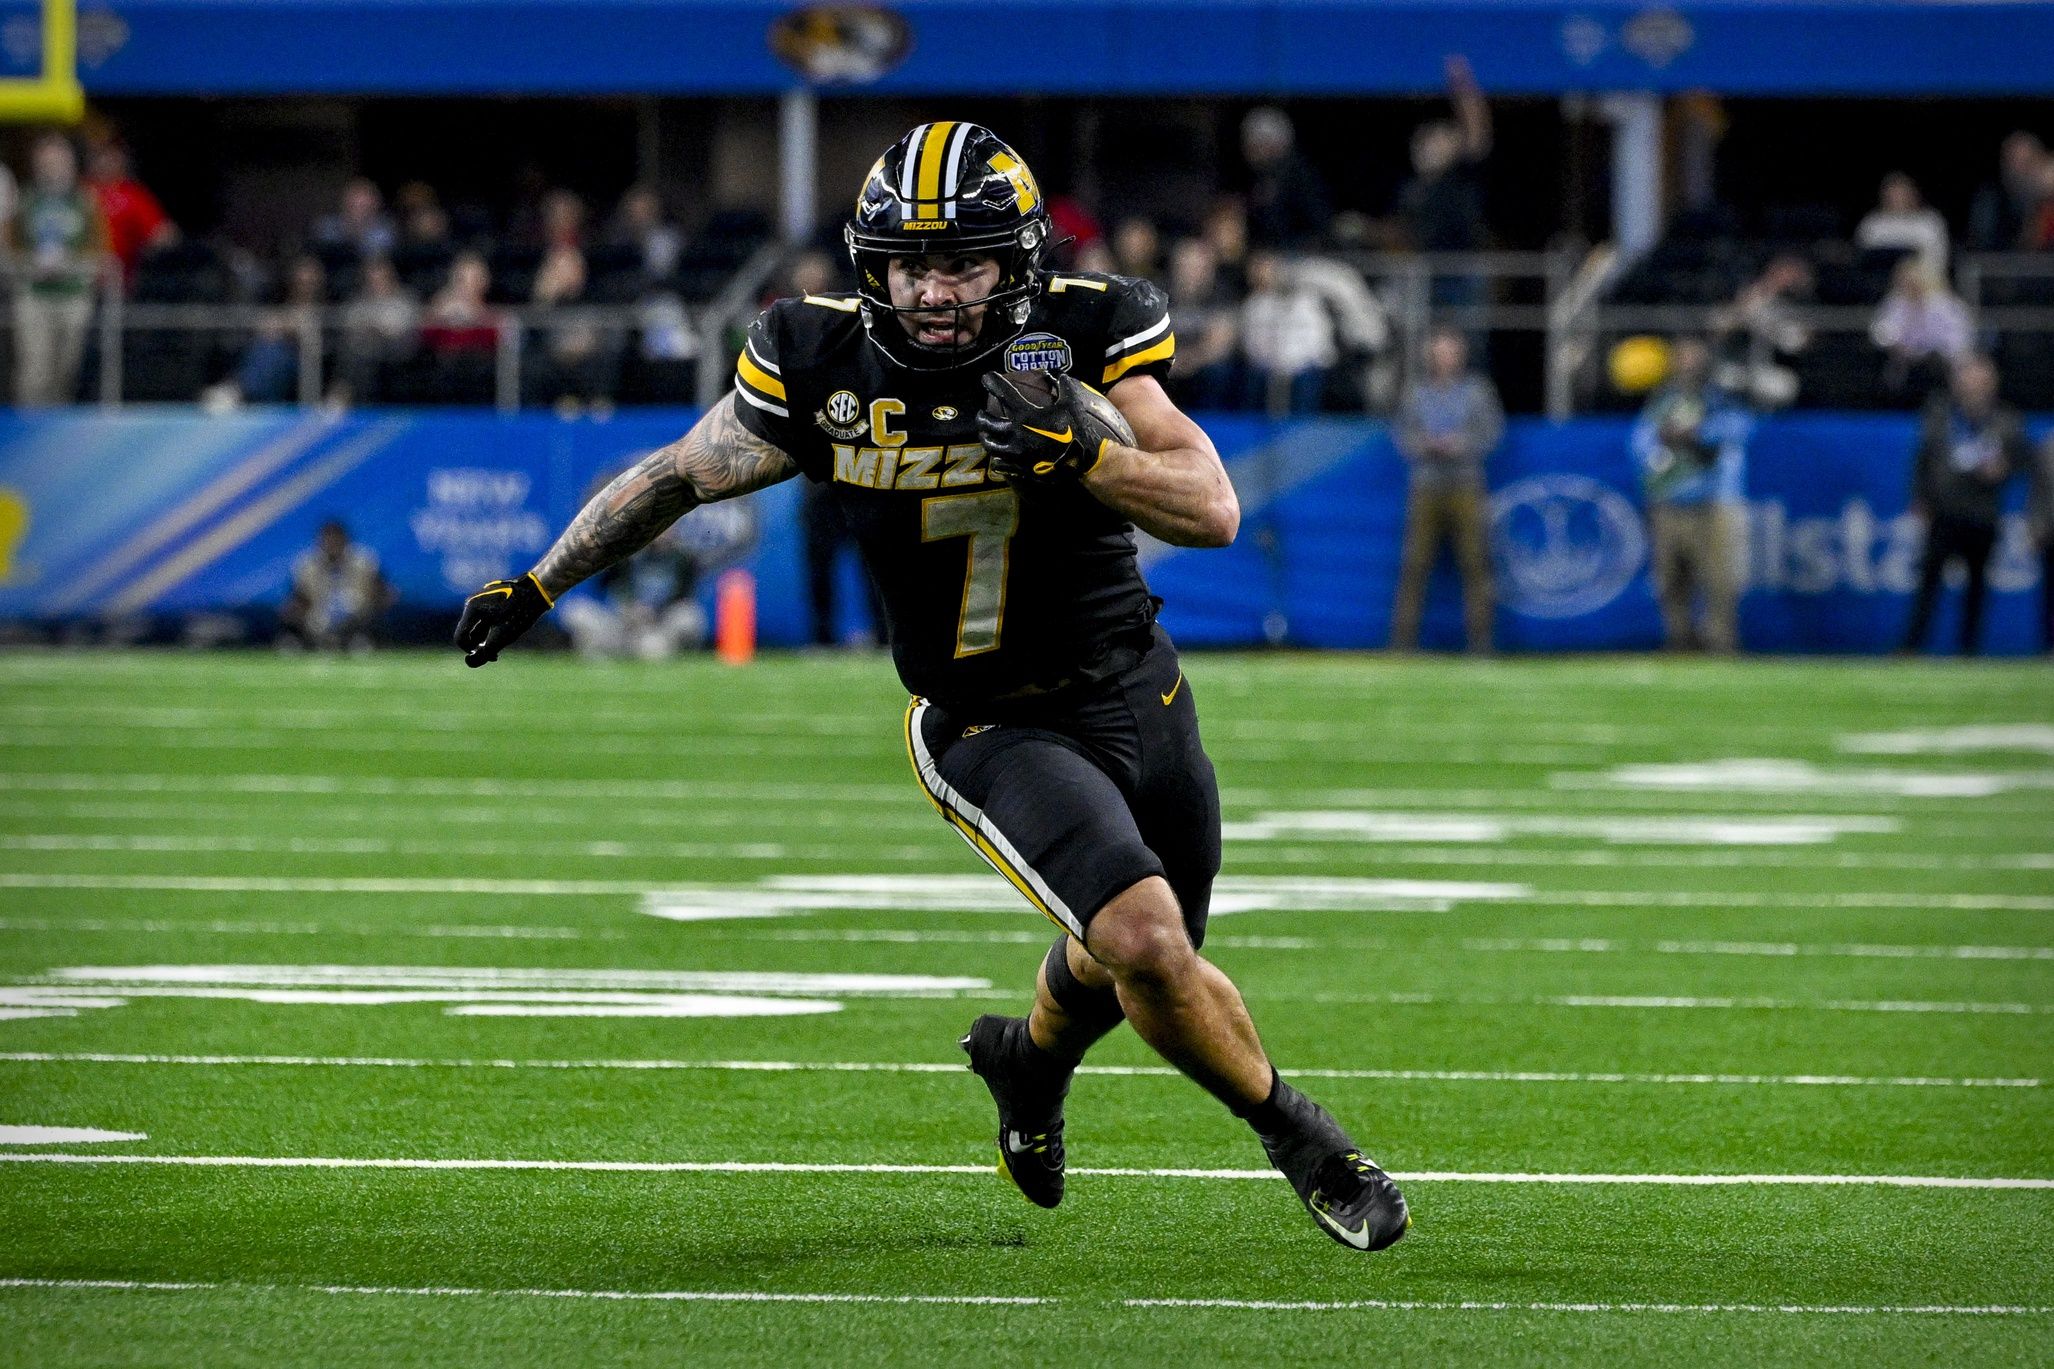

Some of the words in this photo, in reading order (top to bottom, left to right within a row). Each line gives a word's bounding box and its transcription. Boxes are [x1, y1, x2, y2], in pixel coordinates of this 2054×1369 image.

[902, 221, 948, 231] MIZZOU
[1011, 350, 1066, 371] COTTON
[830, 393, 857, 422] SEC
[820, 418, 861, 439] GRADUATE
[869, 398, 908, 447] C
[921, 487, 1020, 659] 7
